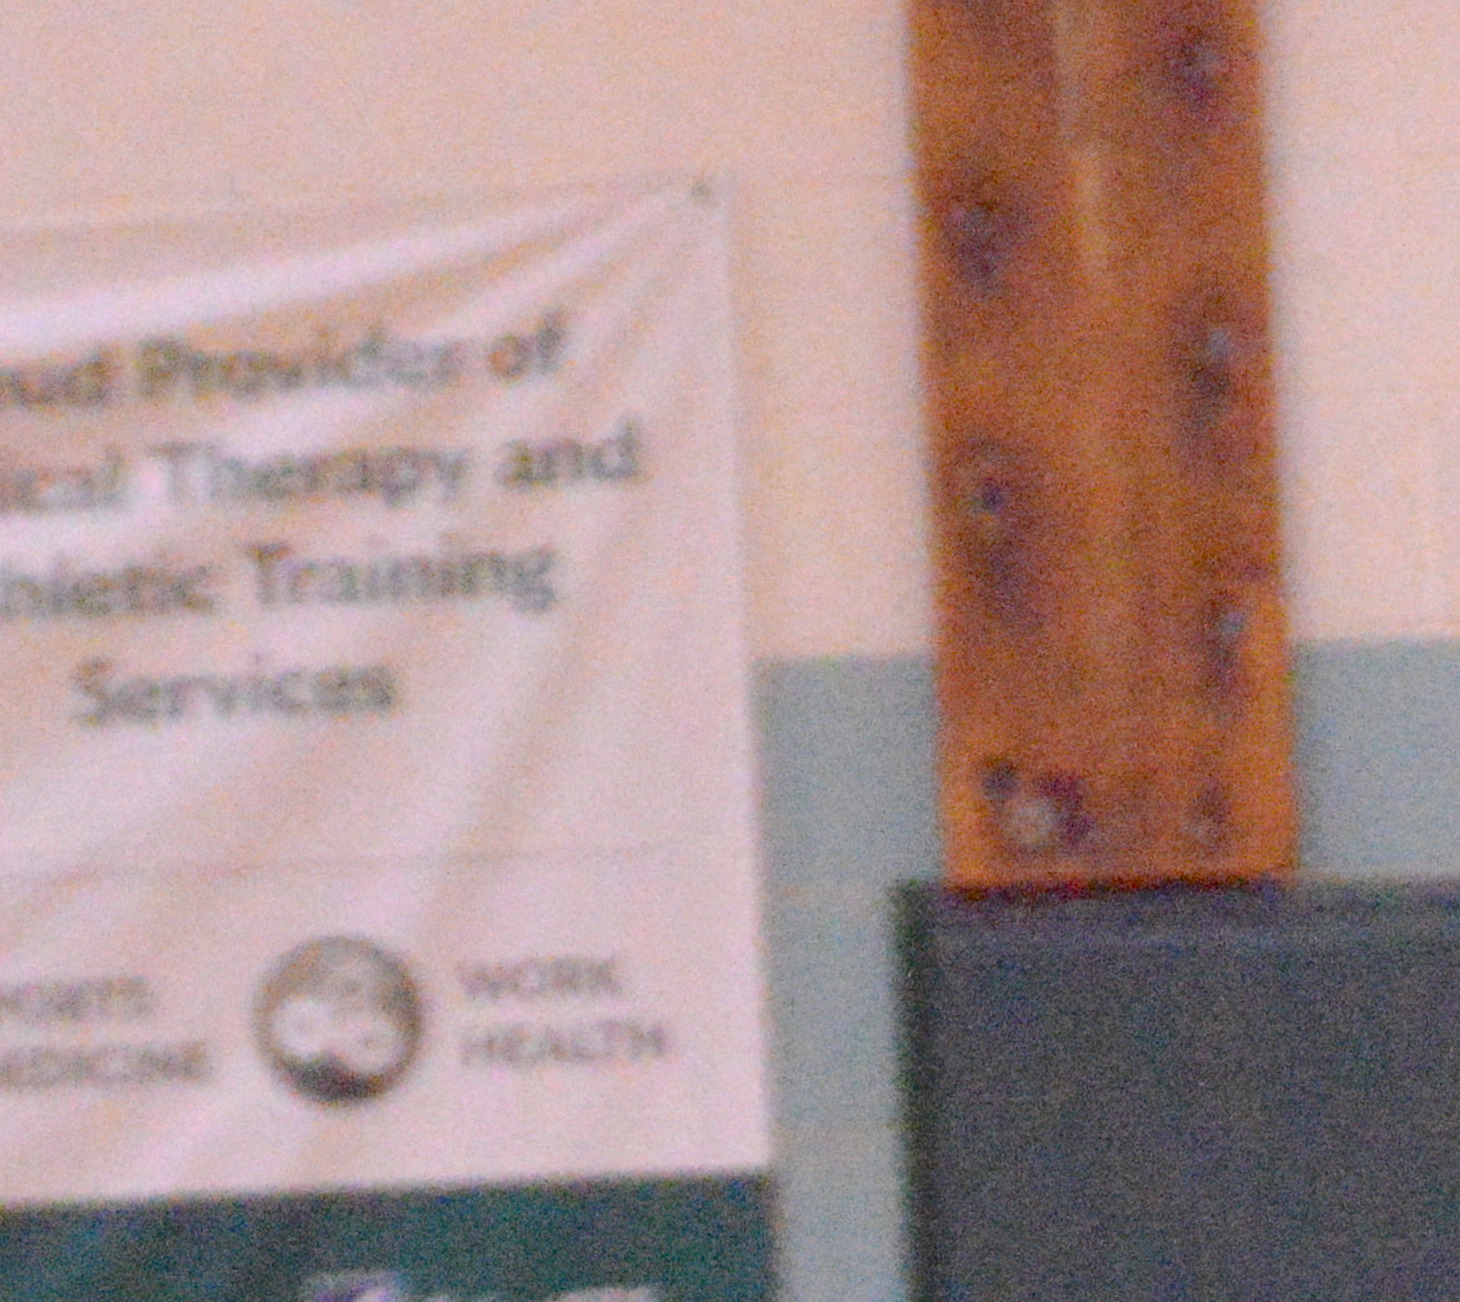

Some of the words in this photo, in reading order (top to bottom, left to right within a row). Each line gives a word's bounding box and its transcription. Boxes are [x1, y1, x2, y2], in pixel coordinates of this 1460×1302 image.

[138, 320, 465, 402] Provider
[492, 306, 572, 382] of
[145, 438, 470, 510] Therapy
[500, 412, 646, 490] and
[242, 540, 560, 616] Training
[74, 655, 402, 732] Services
[454, 953, 623, 1000] WORK
[459, 1018, 669, 1066] HEALTH
